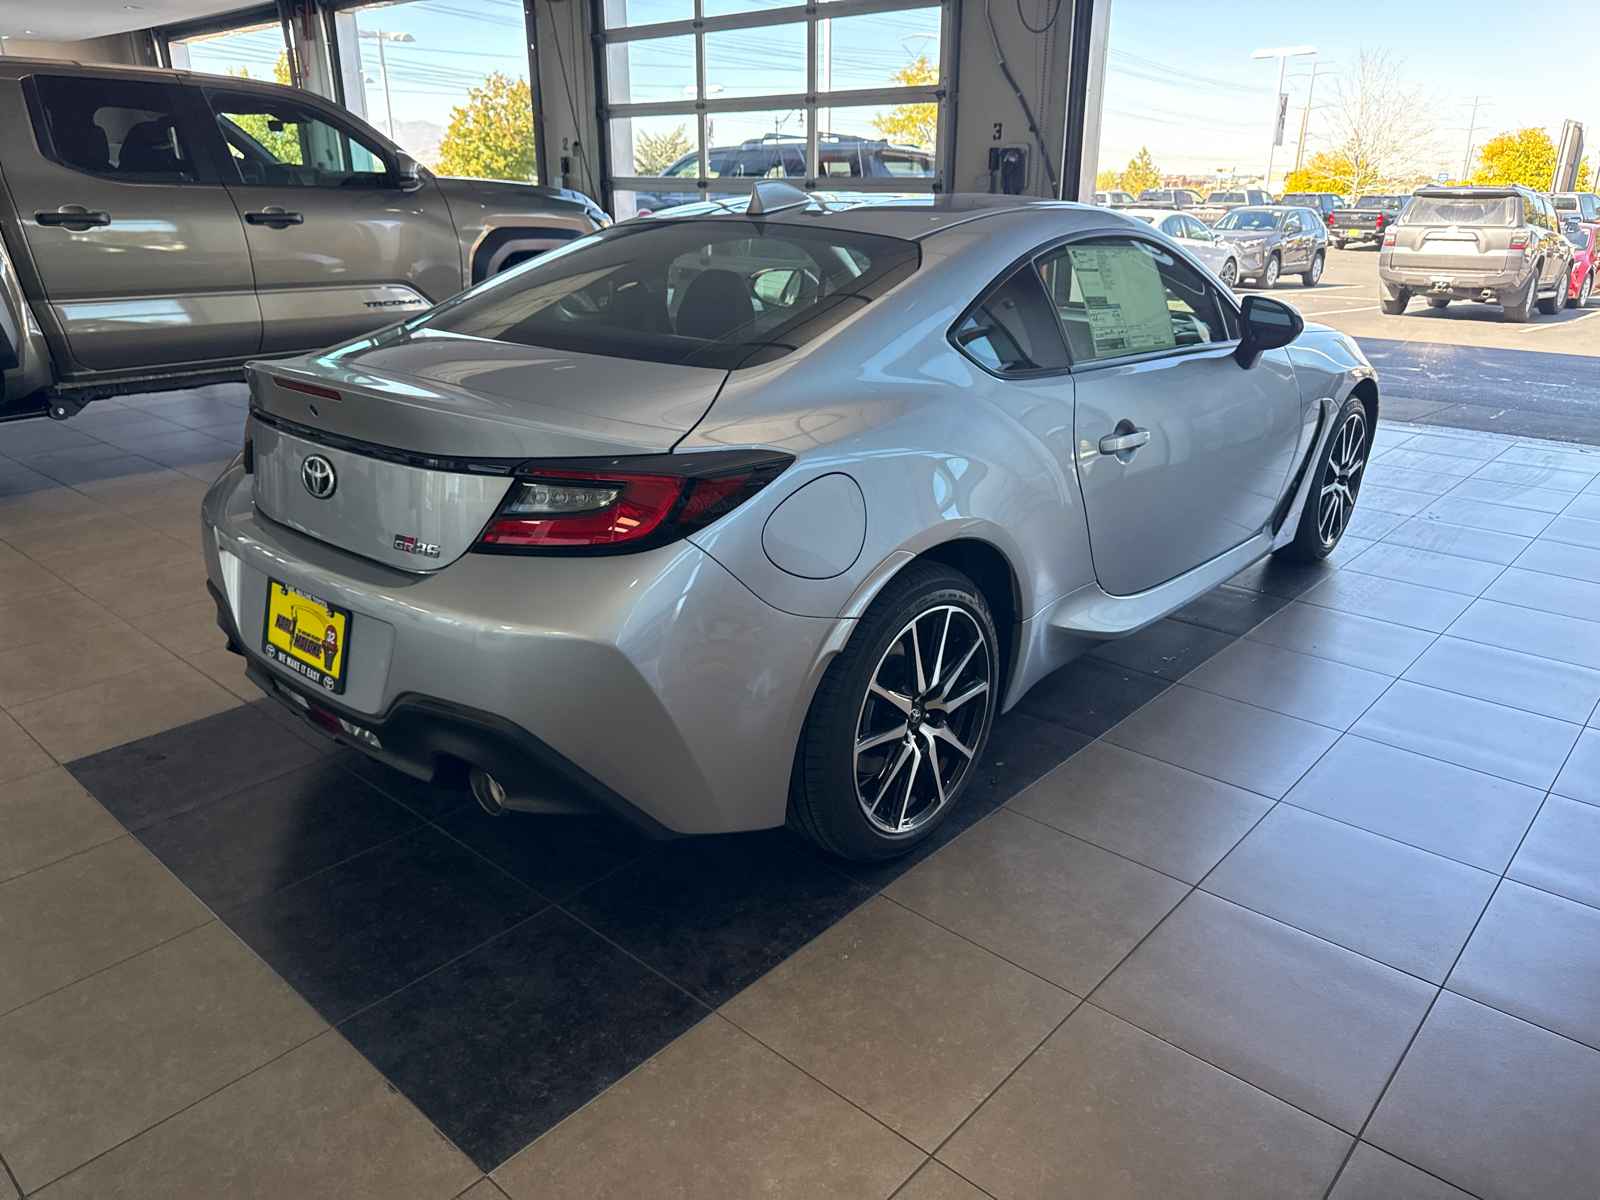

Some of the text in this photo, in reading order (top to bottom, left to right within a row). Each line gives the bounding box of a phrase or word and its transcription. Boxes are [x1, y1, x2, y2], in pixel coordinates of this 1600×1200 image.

[993, 123, 1002, 140] 3
[562, 137, 568, 151] 2
[363, 299, 422, 308] TACOMA
[275, 613, 293, 636] KARL
[326, 630, 336, 645] 32
[293, 633, 323, 660] MALONE
[278, 651, 320, 683] WE MAKE IT EASY
